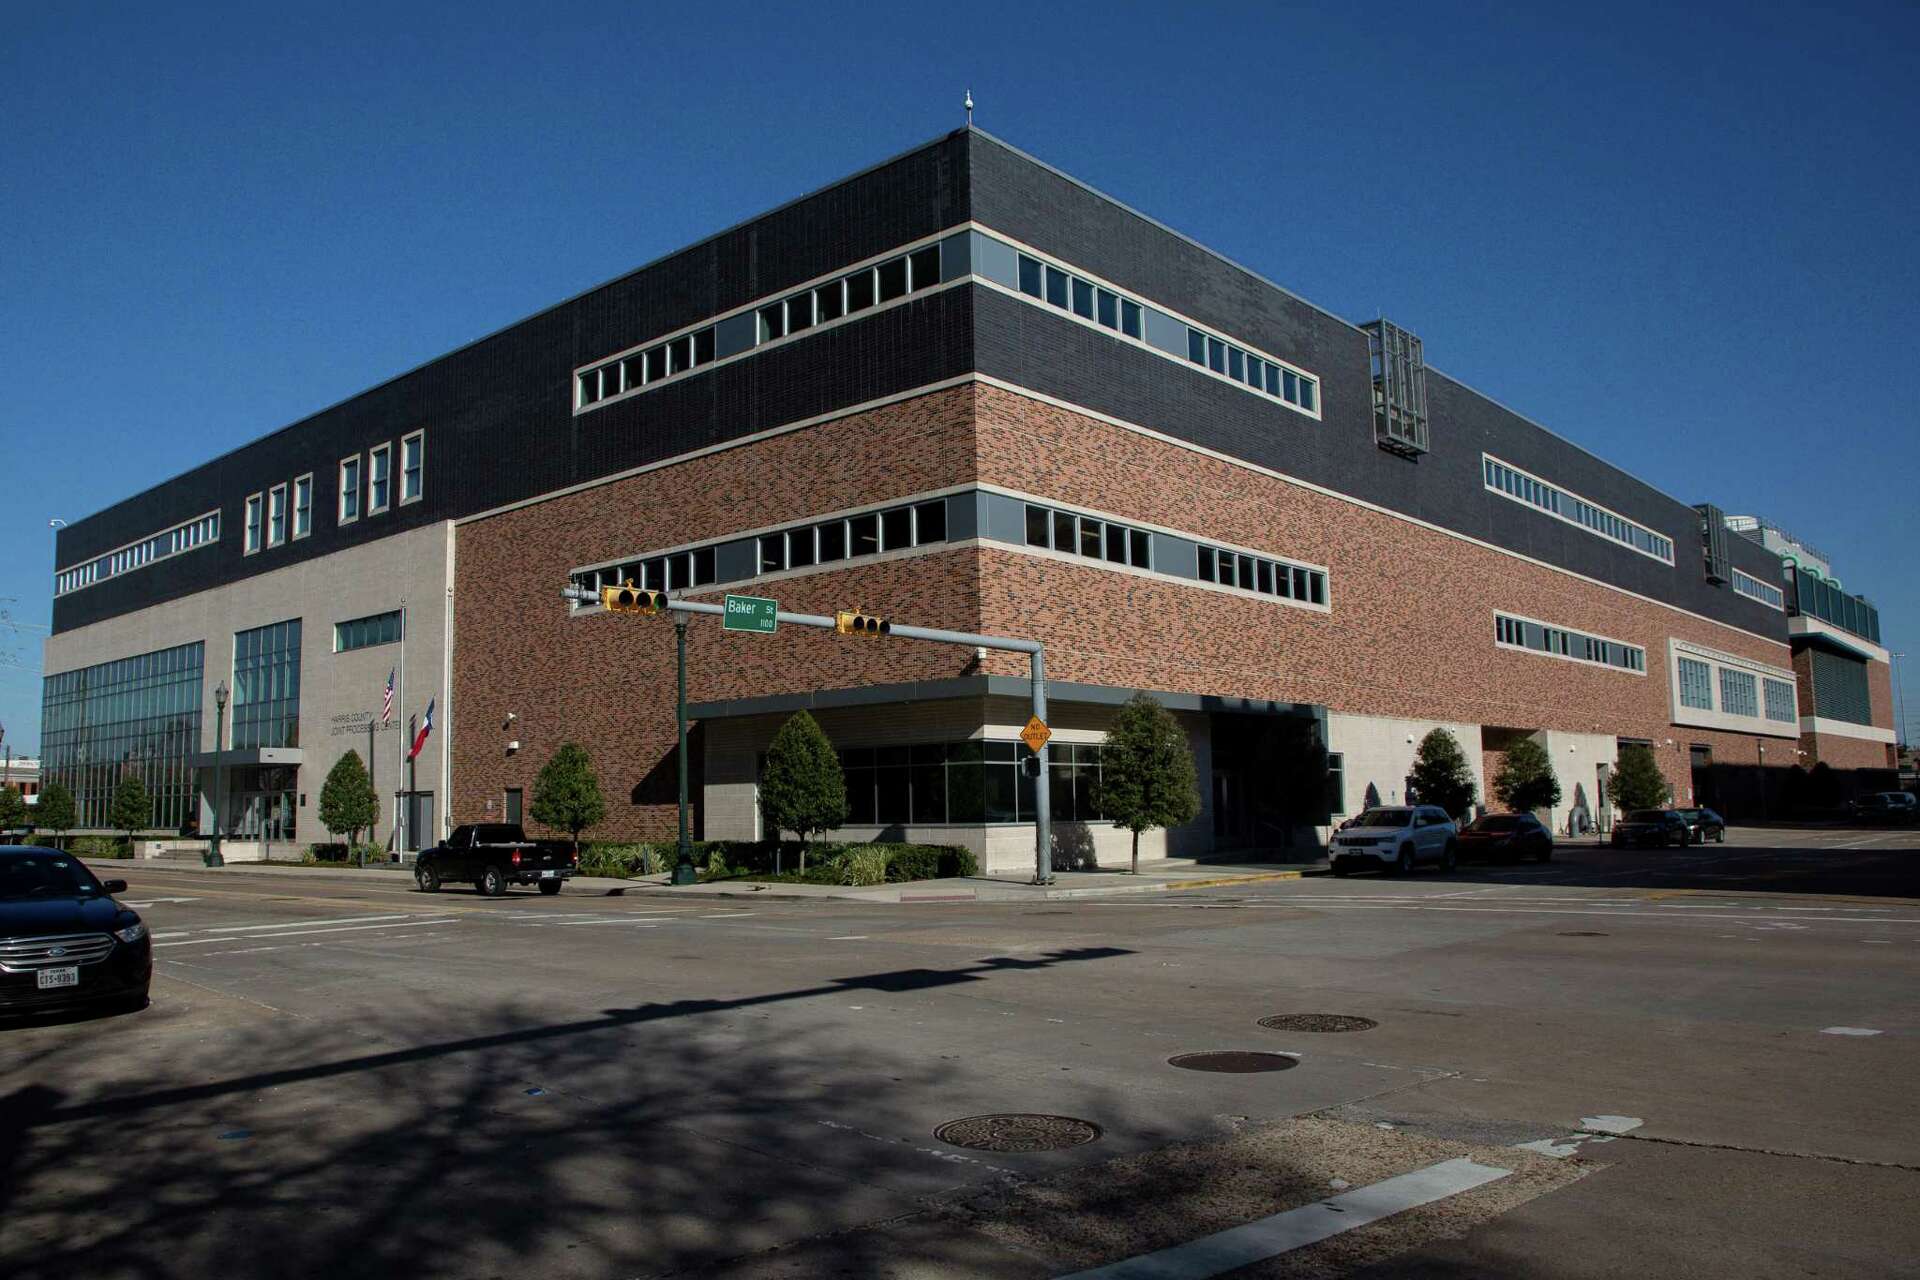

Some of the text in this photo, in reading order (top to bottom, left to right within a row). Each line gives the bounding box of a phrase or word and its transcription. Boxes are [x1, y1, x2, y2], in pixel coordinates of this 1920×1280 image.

[728, 600, 756, 614] Baker
[1031, 723, 1040, 731] NO
[1024, 731, 1048, 741] OUTLET
